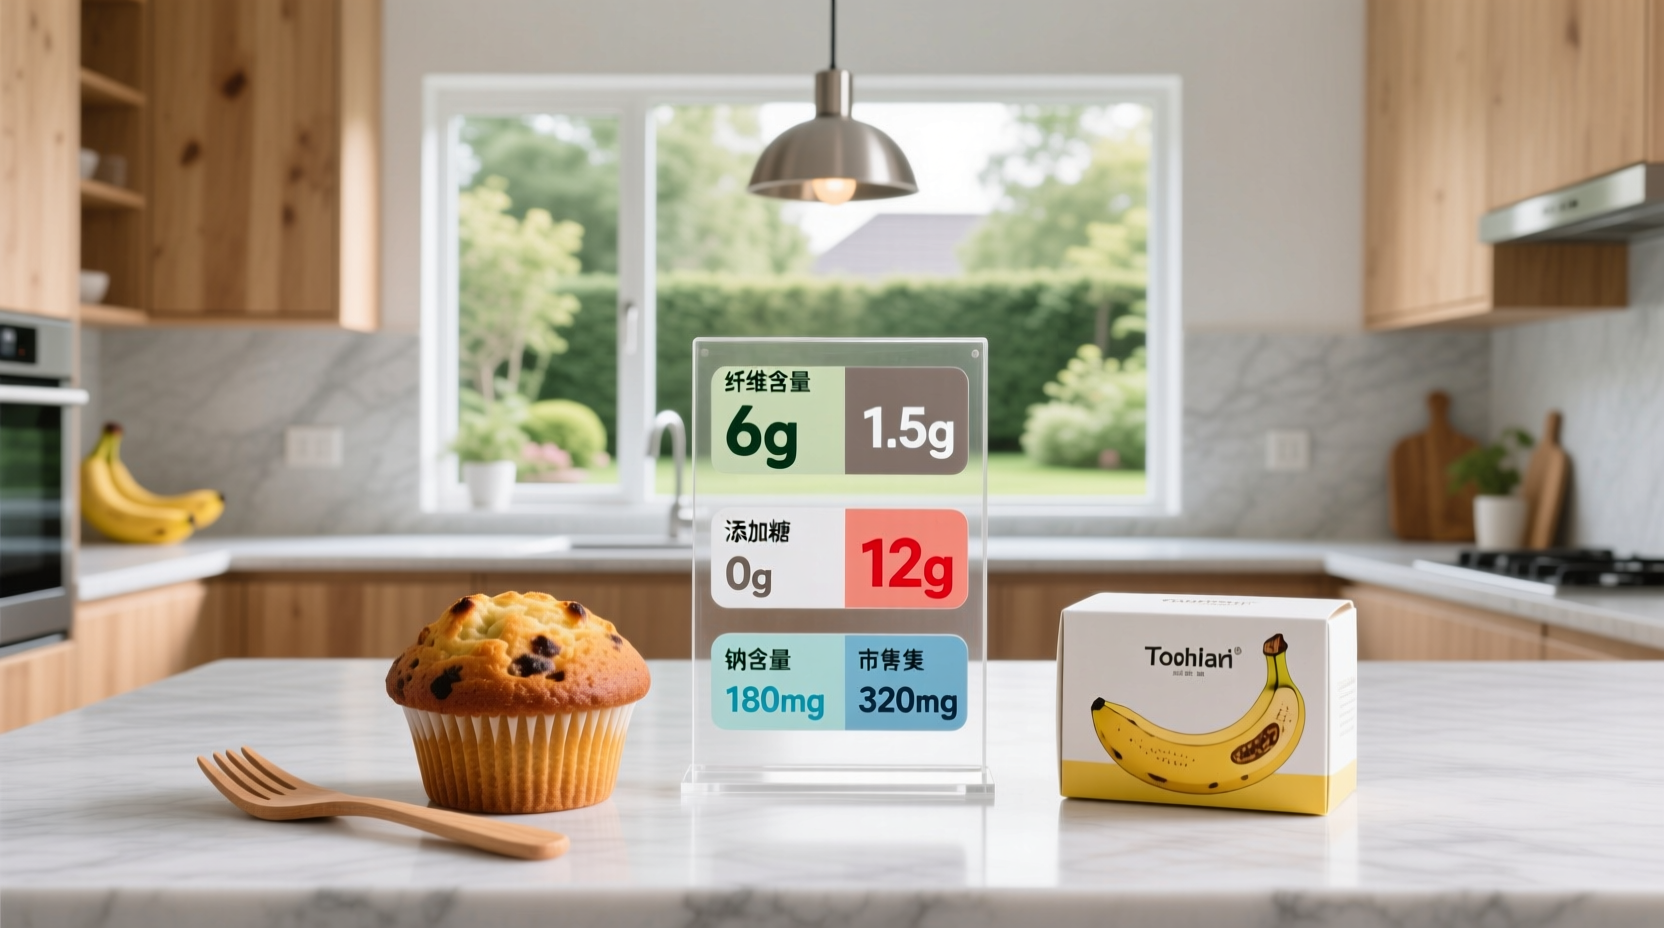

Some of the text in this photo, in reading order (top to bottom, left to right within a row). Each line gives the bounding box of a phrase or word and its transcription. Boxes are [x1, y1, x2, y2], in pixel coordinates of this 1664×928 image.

[724, 369, 811, 393] 纤维含量
[726, 405, 798, 469] 6g
[863, 406, 955, 460] 1.5g
[724, 519, 791, 543] 添加糖
[725, 556, 772, 598] 0g
[861, 537, 954, 599] 12g
[725, 647, 791, 671] 钠含量
[726, 685, 825, 721] 180mg
[858, 686, 958, 721] 320mg
